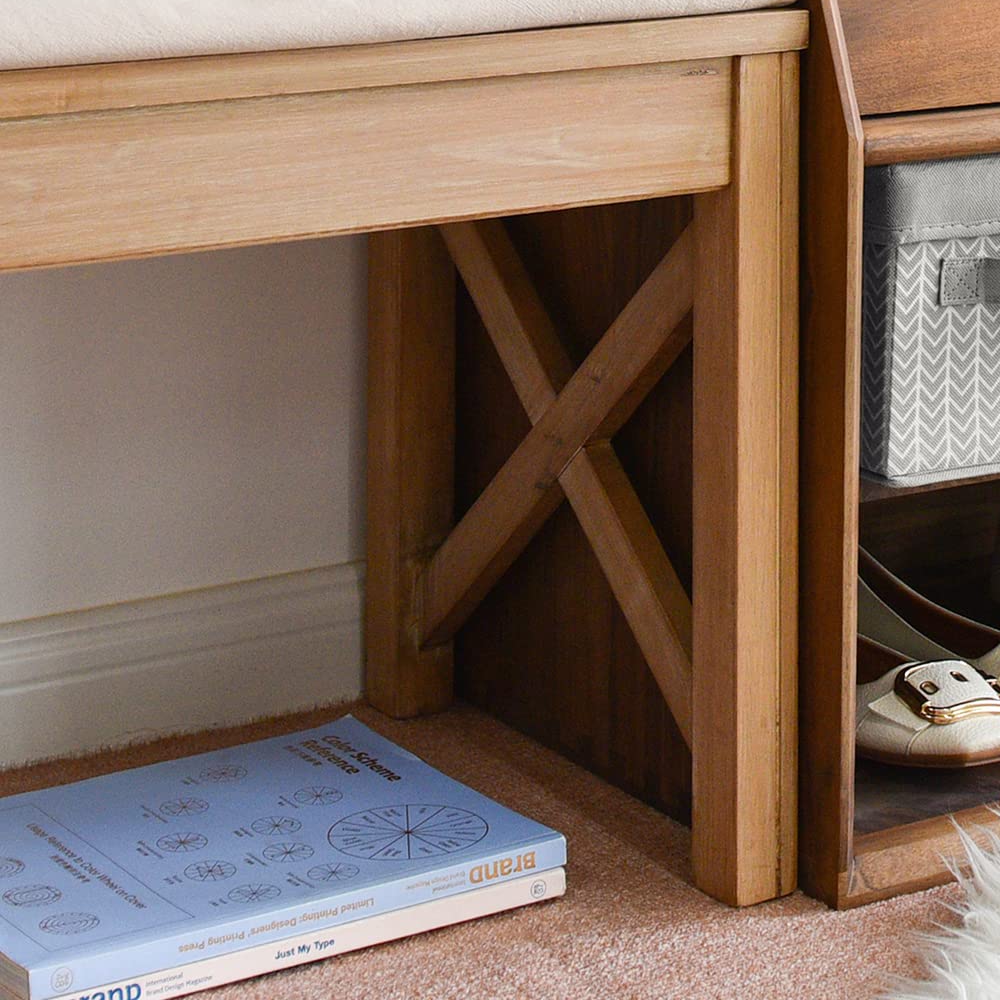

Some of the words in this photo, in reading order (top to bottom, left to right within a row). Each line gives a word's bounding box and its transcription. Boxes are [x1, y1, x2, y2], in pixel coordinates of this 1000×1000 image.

[299, 740, 360, 775] Reference
[321, 735, 357, 753] Color
[350, 752, 401, 782] Scheme
[124, 895, 147, 909] Cover
[341, 898, 374, 914] Limited
[207, 931, 245, 946] Printing
[178, 941, 205, 952] Press
[275, 948, 295, 960] Just
[297, 943, 311, 954] My
[314, 939, 335, 950] Type
[145, 972, 183, 987] International
